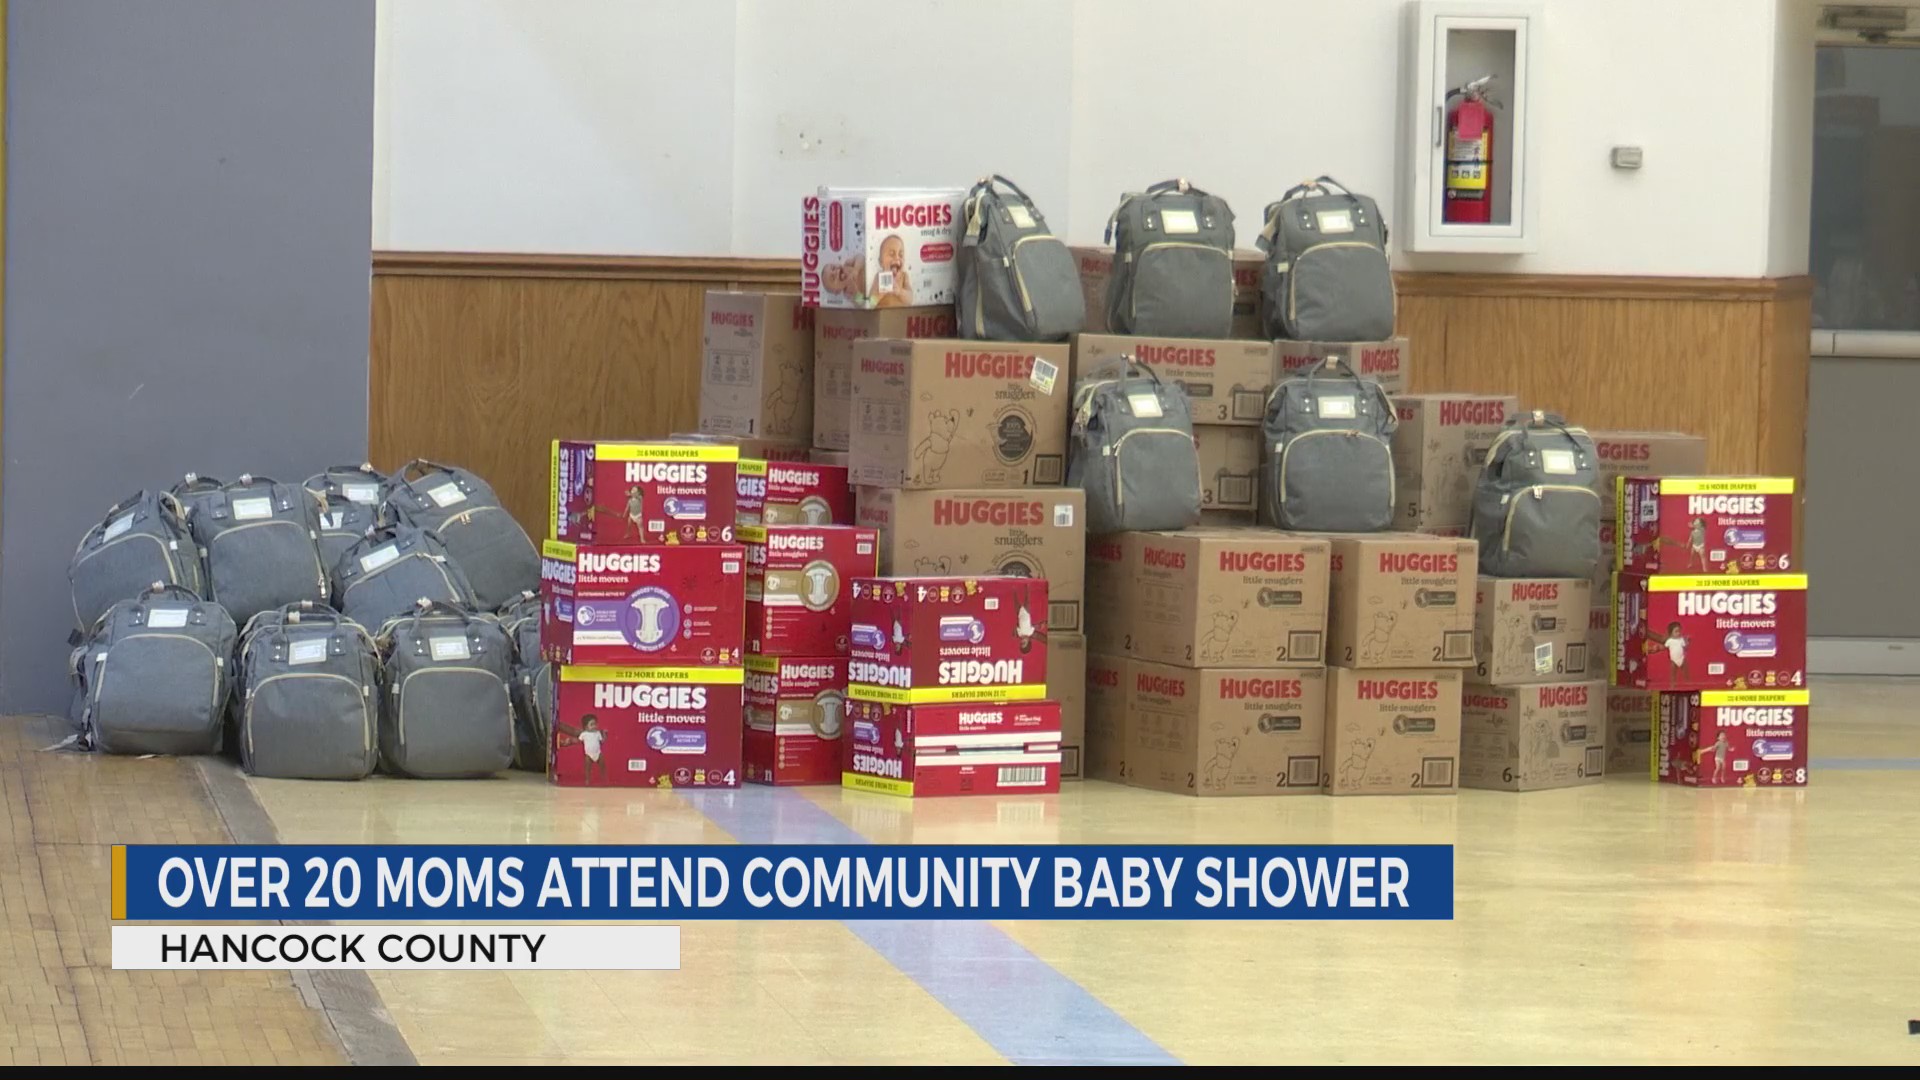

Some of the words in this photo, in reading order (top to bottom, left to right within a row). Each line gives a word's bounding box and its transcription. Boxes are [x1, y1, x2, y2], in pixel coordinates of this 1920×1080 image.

[875, 204, 952, 230] HUGGIES
[803, 197, 820, 307] HUGGIES
[711, 311, 754, 328] HUGGIES
[1135, 345, 1215, 367] HUGGIES
[1361, 348, 1399, 374] HUGGIES
[861, 358, 905, 376] HUGGIES
[945, 352, 1036, 379] HUGGIES
[1165, 368, 1187, 378] little
[1188, 370, 1215, 379] movers
[994, 388, 1036, 402] snugglers
[1217, 404, 1228, 420] 3
[1440, 400, 1504, 426] HUGGIES
[670, 449, 699, 458] DIAPERS
[625, 462, 707, 483] HUGGIES
[769, 468, 820, 486] HUGGIES
[1022, 469, 1029, 485] 1
[558, 448, 569, 536] HUGGIES
[656, 485, 677, 495] little
[677, 486, 707, 495] movers
[737, 478, 766, 497] GIES
[1202, 489, 1213, 504] 3
[933, 500, 1044, 526] HUGGIES
[1407, 502, 1417, 518] 5
[1688, 495, 1765, 515] HUGGIES
[1624, 484, 1633, 566] HUGGIES
[1717, 517, 1735, 526] little
[1736, 518, 1765, 526] movers
[721, 525, 732, 542] 6
[994, 534, 1043, 548] snugglers
[769, 535, 824, 550] HUGGIES
[578, 553, 661, 573] HUGGIES
[1144, 546, 1186, 570] HUGGIES
[1219, 551, 1305, 572] HUGGIES
[1379, 553, 1457, 573] HUGGIES
[1778, 554, 1789, 570] 6
[541, 558, 576, 585] HUGGIES
[578, 575, 598, 583] little
[598, 575, 629, 584] movers
[1242, 575, 1263, 585] little
[1264, 576, 1304, 586] snugglers
[1400, 576, 1419, 586] little
[1420, 577, 1457, 587] snugglers
[852, 582, 862, 599] 4
[917, 586, 928, 603] 4
[1511, 583, 1559, 601] HUGGIES
[1678, 592, 1776, 616] HUGGIES
[1716, 619, 1739, 629] little
[1740, 620, 1776, 629] movers
[1124, 634, 1131, 650] 2
[731, 648, 739, 658] 4
[851, 650, 874, 658] movers
[875, 652, 891, 662] little
[940, 647, 970, 656] movers
[971, 646, 991, 657] little
[1185, 645, 1192, 661] 2
[1276, 646, 1286, 662] 2
[1345, 647, 1352, 662] 2
[1432, 647, 1442, 662] 2
[781, 665, 834, 680] HUGGIES
[939, 660, 1023, 684] HUGGIES
[1477, 661, 1487, 677] 6
[1556, 658, 1564, 674] 6
[848, 663, 911, 688] HUGGIES
[1790, 670, 1802, 686] 4
[1137, 673, 1185, 698] HUGGIES
[1219, 678, 1302, 699] HUGGIES
[1357, 680, 1438, 700] HUGGIES
[594, 684, 707, 709] HUGGIES
[1463, 694, 1508, 710] UGGIES
[1539, 686, 1588, 708] HUGGIES
[1757, 694, 1786, 702] DIAPERS
[845, 701, 853, 716] 4
[1244, 702, 1264, 711] little
[1265, 702, 1303, 712] snugglers
[1379, 703, 1398, 712] little
[1399, 704, 1436, 713] snugglers
[638, 712, 664, 724] little
[665, 714, 706, 724] movers
[959, 712, 1003, 725] HUGGIES
[1717, 708, 1794, 726] HUGGIES
[1659, 694, 1671, 776] HUGGIES
[1746, 729, 1763, 737] little
[853, 755, 902, 778] HUGGIES
[1119, 761, 1126, 777] 2
[1577, 763, 1584, 778] 6
[723, 769, 736, 786] 4
[1187, 772, 1194, 788] 2
[1276, 772, 1287, 788] 2
[1322, 773, 1331, 788] 2
[1410, 773, 1421, 788] 2
[1502, 767, 1512, 783] 6
[1795, 768, 1806, 783] 8
